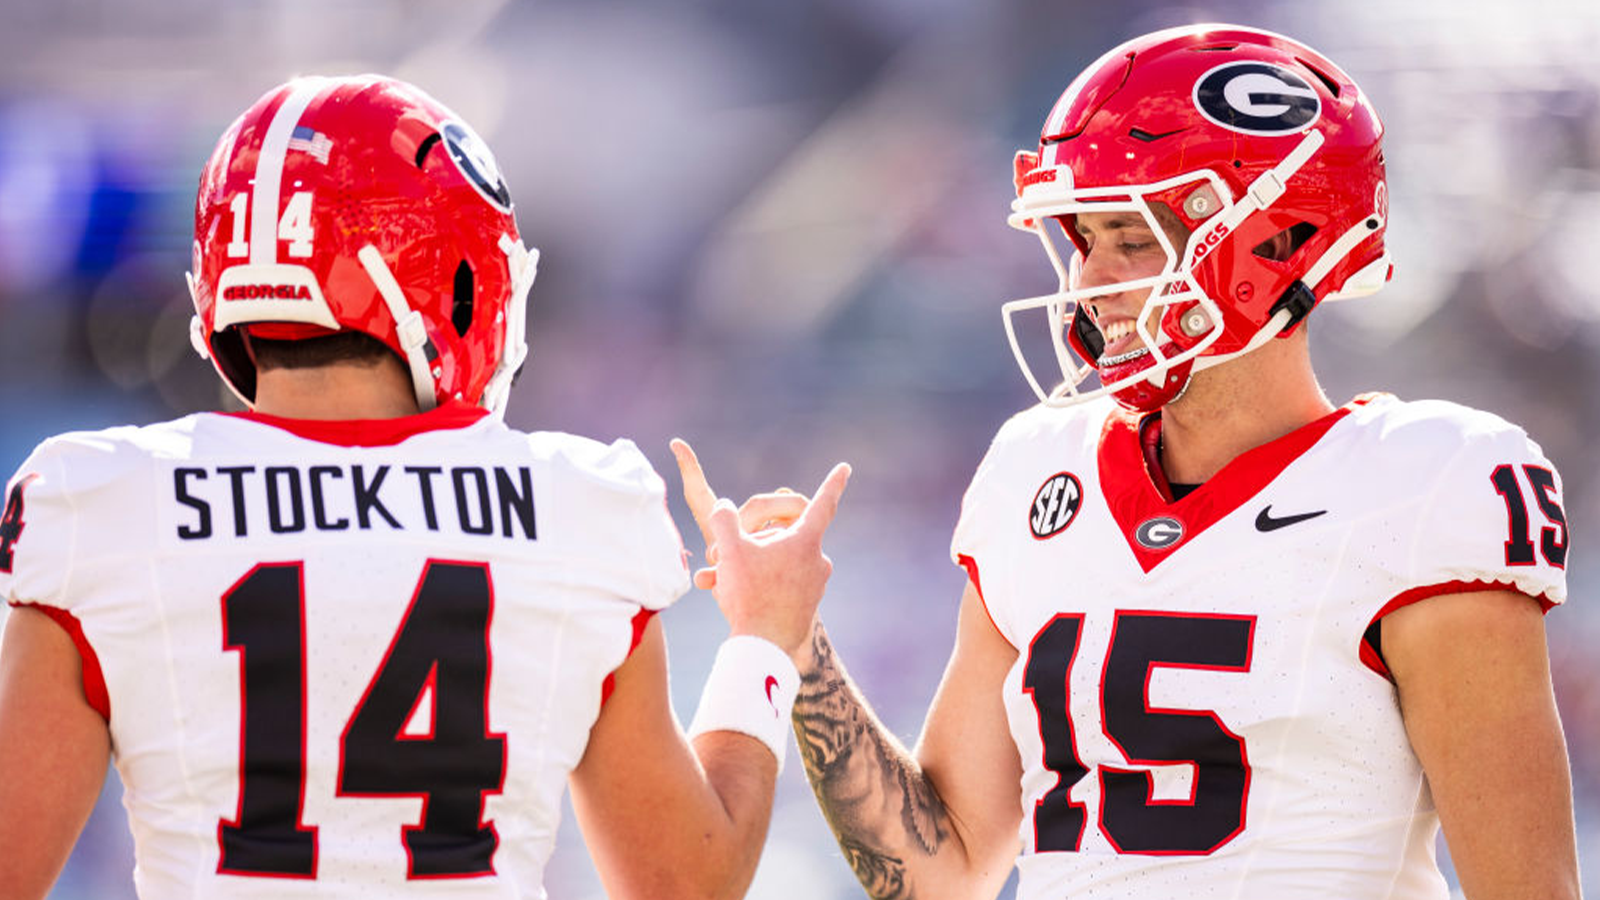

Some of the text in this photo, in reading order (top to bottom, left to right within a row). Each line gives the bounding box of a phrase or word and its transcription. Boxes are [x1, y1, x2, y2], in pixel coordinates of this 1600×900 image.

[227, 192, 314, 258] 14
[223, 284, 313, 301] GEORGIA
[174, 465, 538, 541] STOCKTON
[1031, 475, 1079, 535] SEC
[1489, 463, 1569, 571] 15
[216, 557, 508, 880] 14
[1022, 608, 1258, 856] 15
